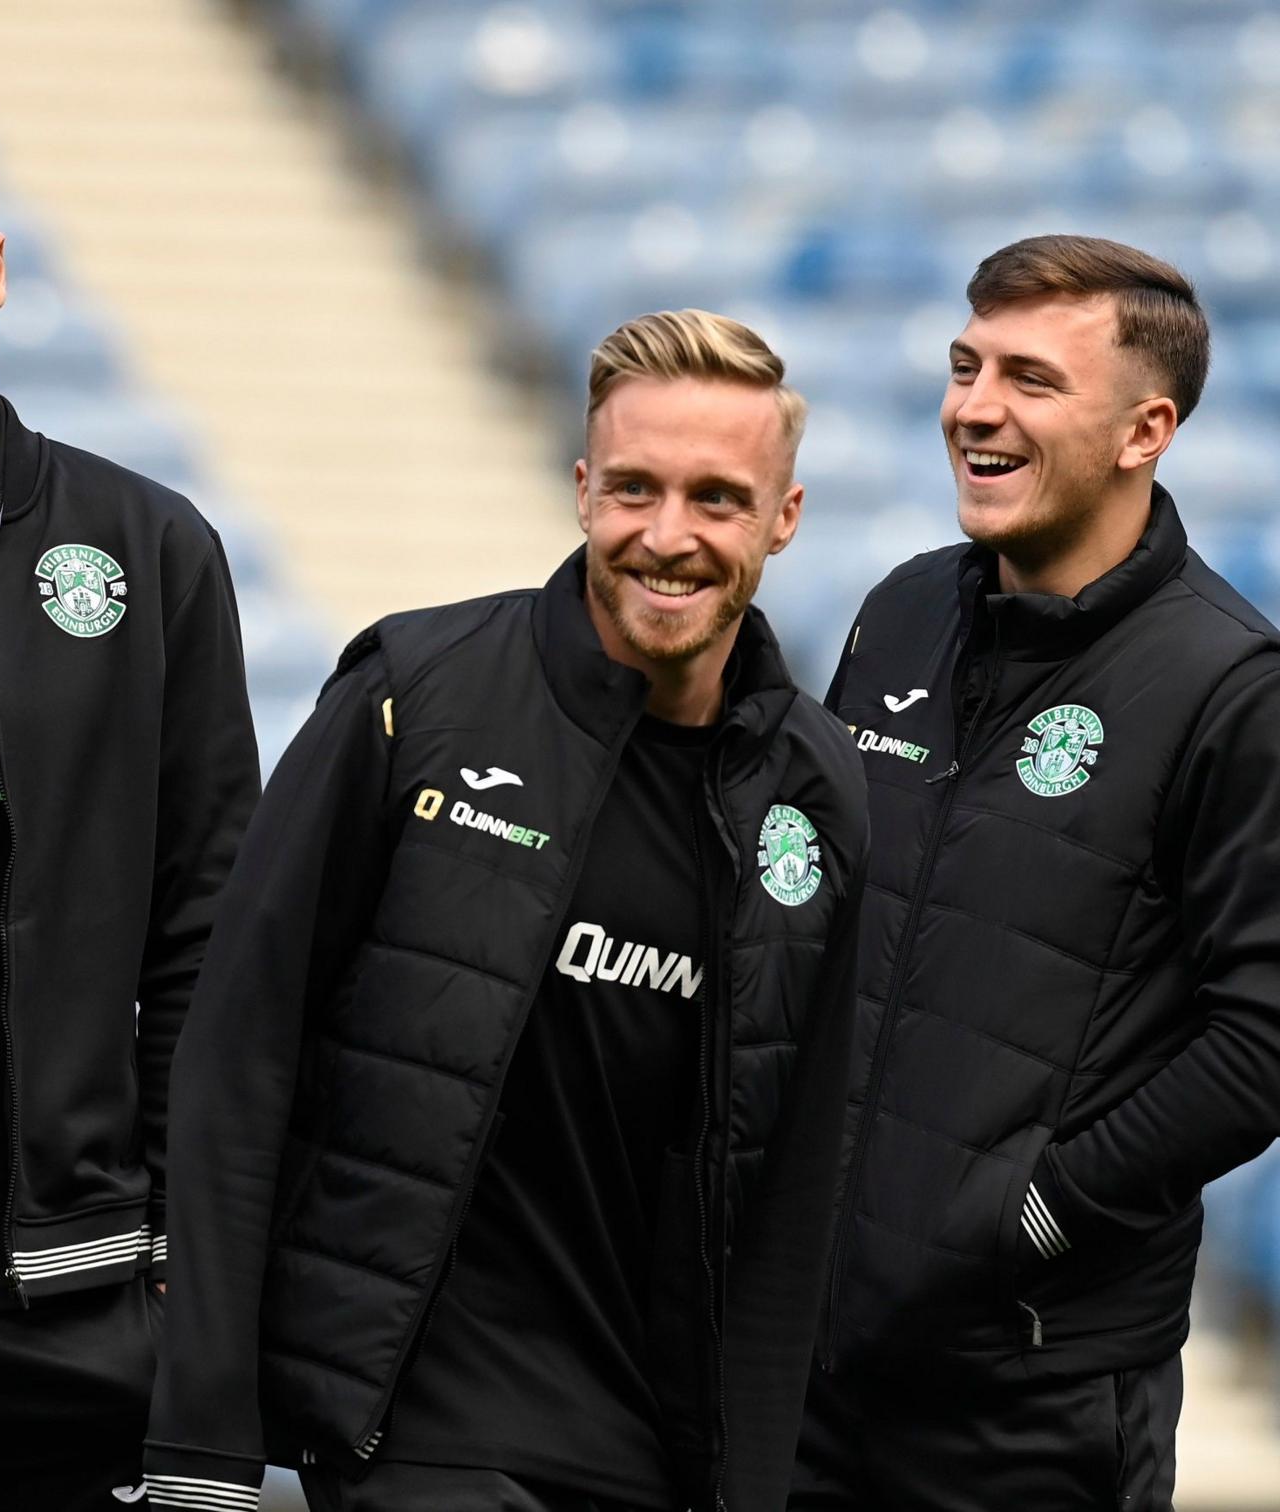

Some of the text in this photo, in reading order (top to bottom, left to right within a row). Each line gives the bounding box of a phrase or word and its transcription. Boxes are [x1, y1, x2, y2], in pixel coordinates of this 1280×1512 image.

[41, 548, 115, 574] HIBERNIAN
[51, 606, 118, 633] EDINBURGH
[1035, 707, 1101, 741] HIBERNIAN
[857, 729, 930, 764] QUINNBET
[1020, 764, 1082, 795] EDINBURGH
[413, 788, 551, 850] Q QUINNBET
